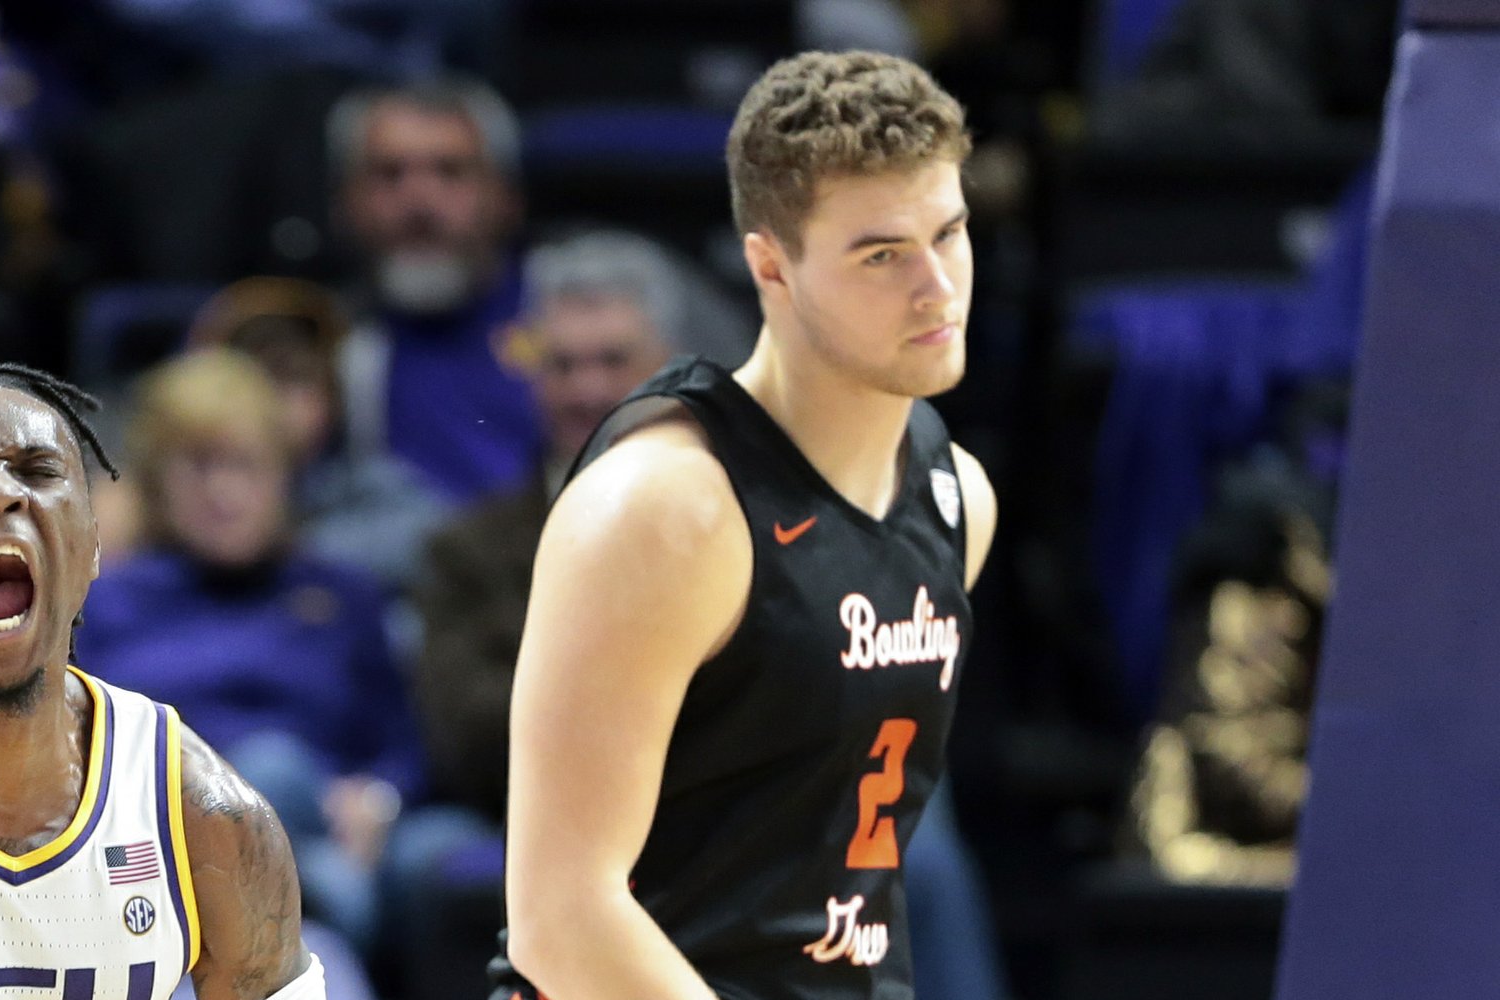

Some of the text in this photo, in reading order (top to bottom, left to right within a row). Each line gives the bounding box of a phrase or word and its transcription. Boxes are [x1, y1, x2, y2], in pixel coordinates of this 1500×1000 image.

[840, 584, 960, 692] Bowling
[845, 717, 918, 869] 2
[124, 897, 155, 934] SEC
